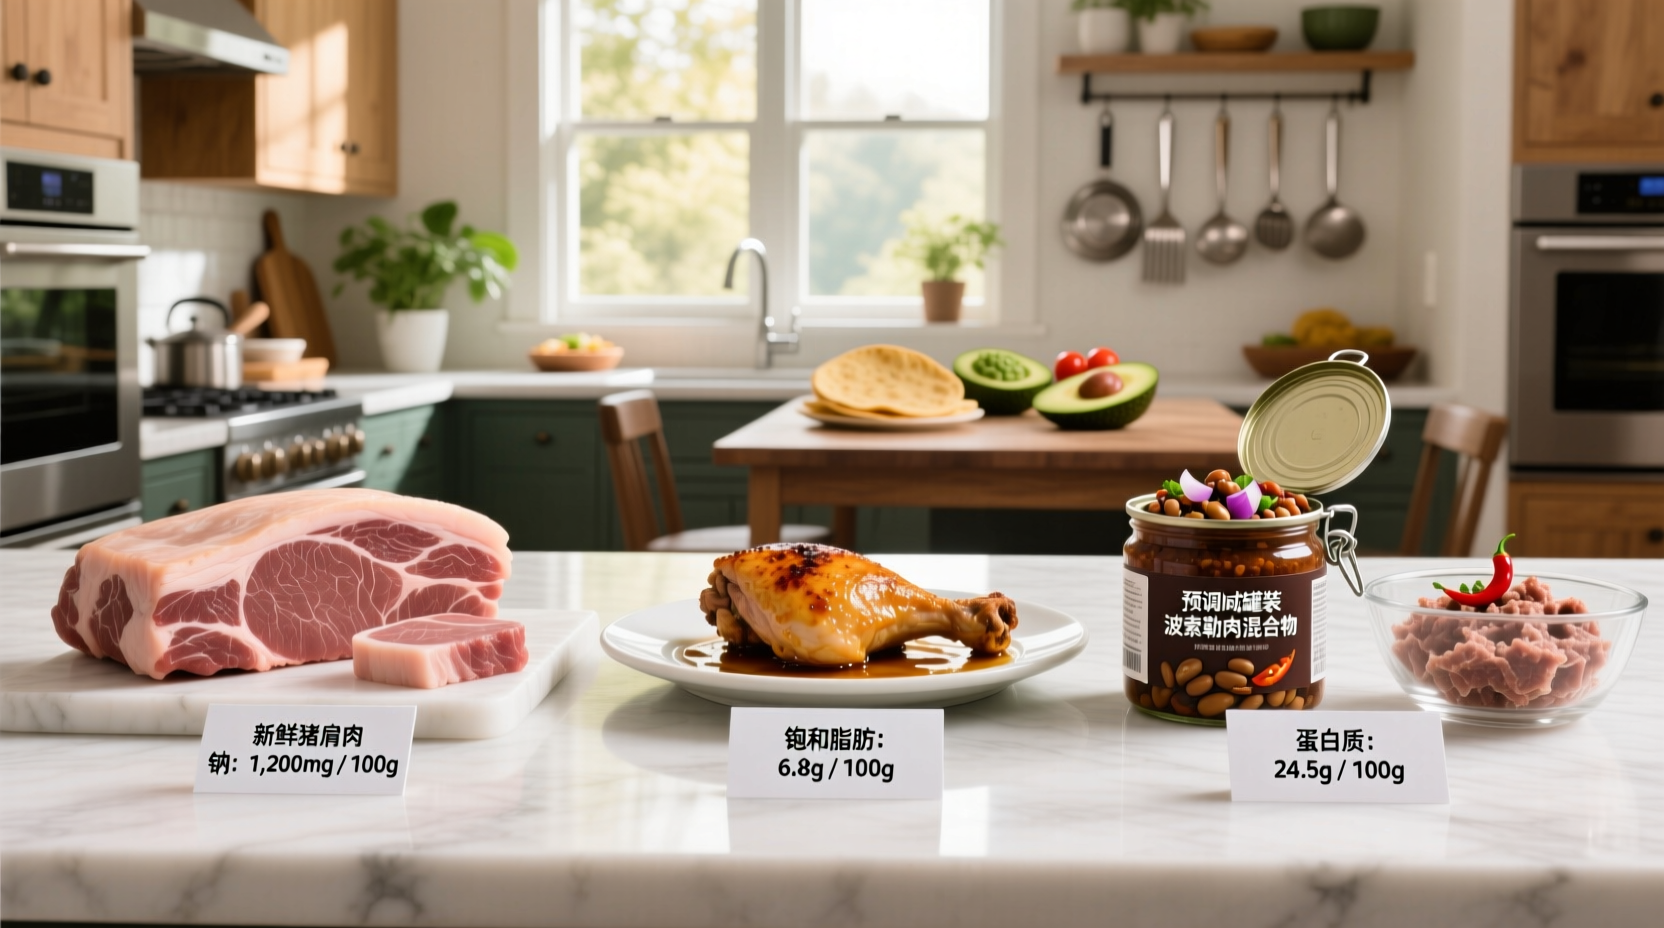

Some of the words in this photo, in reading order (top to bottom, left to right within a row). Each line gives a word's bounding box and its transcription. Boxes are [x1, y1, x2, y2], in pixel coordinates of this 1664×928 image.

[252, 722, 364, 748] 新鲜猪肩肉
[784, 726, 884, 752] 饱和脂肪：
[1296, 728, 1374, 753] 蛋白质：
[250, 754, 334, 778] 1,200mg
[778, 757, 824, 783] 6.8g
[843, 758, 895, 784] 100g
[1274, 759, 1332, 786] 24.5g
[1352, 760, 1405, 786] 100g
